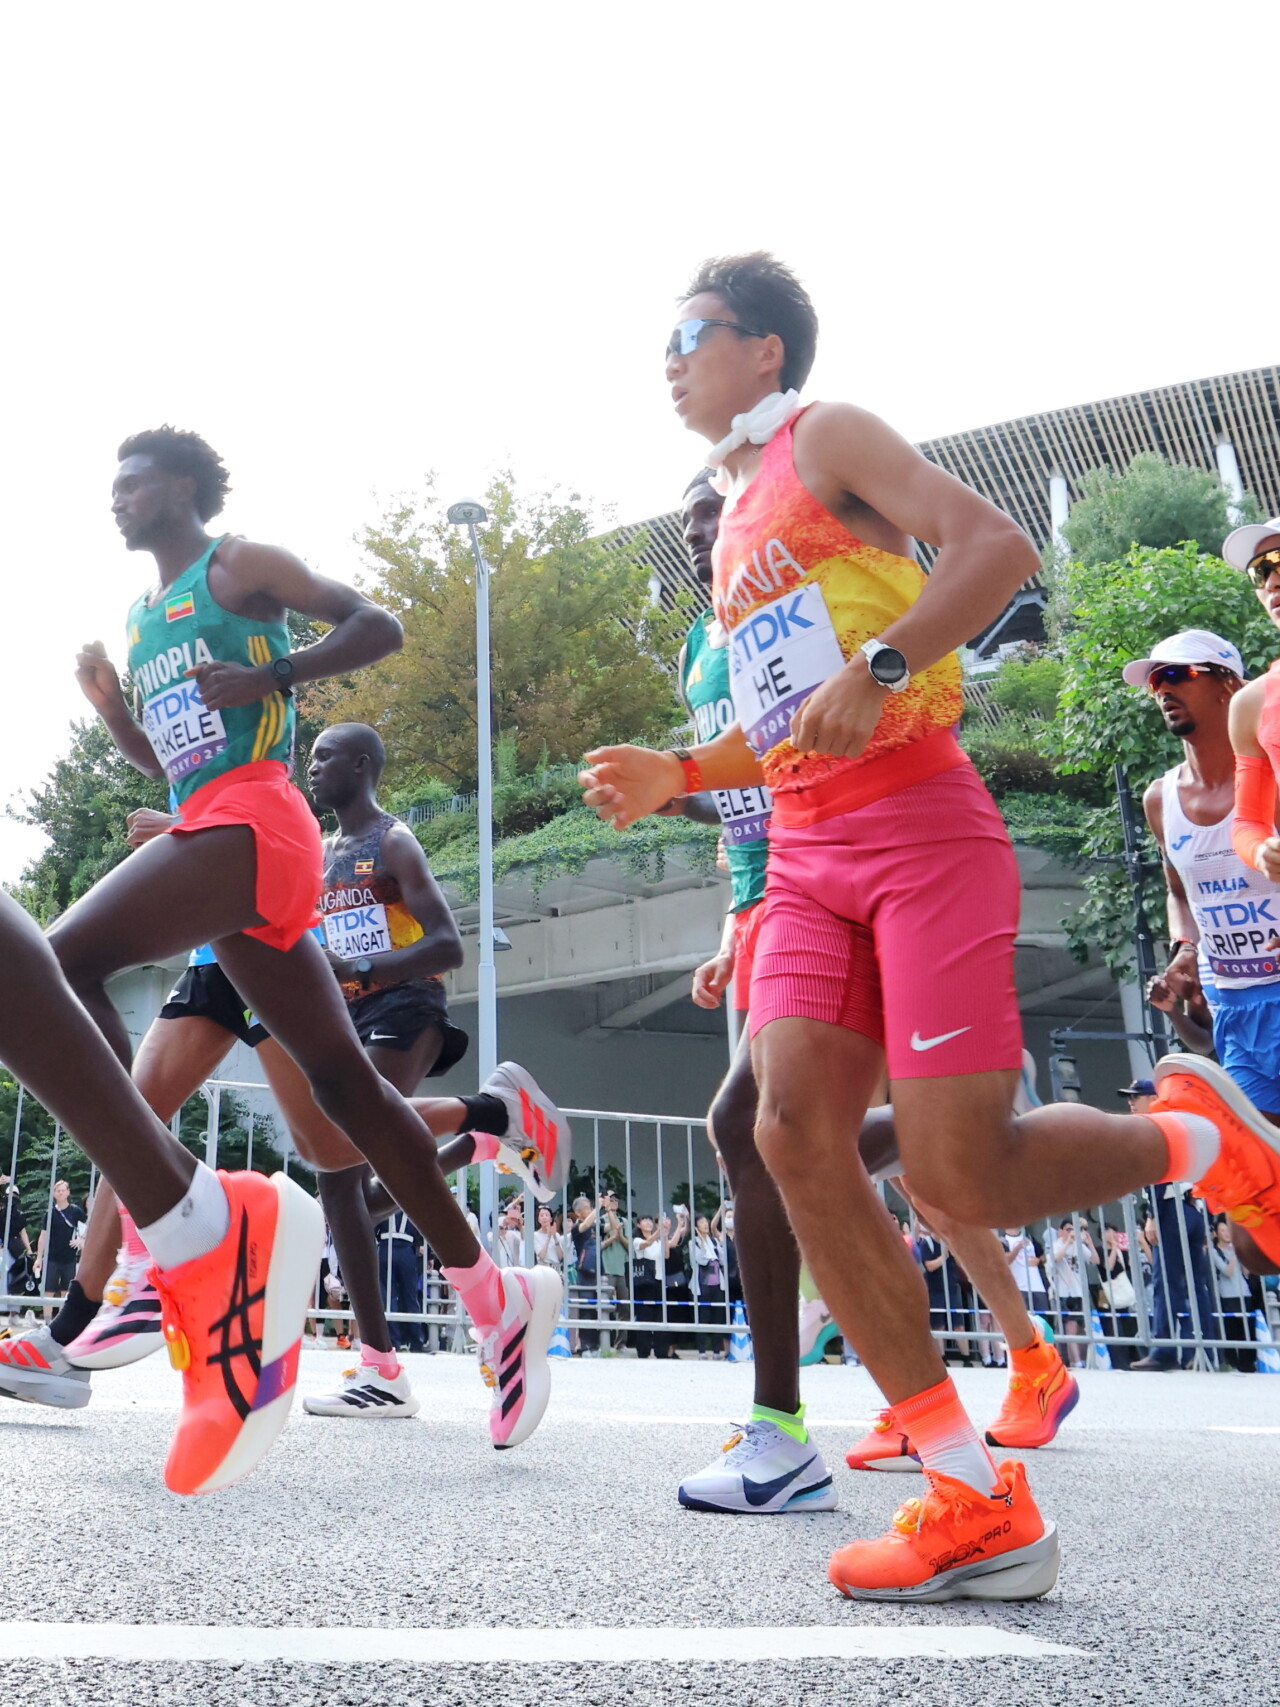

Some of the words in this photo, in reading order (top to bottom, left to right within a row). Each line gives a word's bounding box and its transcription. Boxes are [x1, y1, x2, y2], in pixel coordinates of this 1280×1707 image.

[734, 593, 815, 662] TDK
[752, 656, 793, 709] HE
[149, 682, 206, 726] TDK
[761, 704, 797, 741] TOKY
[319, 888, 378, 912] UGANDA
[1198, 877, 1249, 895] ITALIA
[331, 907, 379, 933] TDK
[1202, 898, 1279, 928] TDK
[983, 1520, 1012, 1544] PRO
